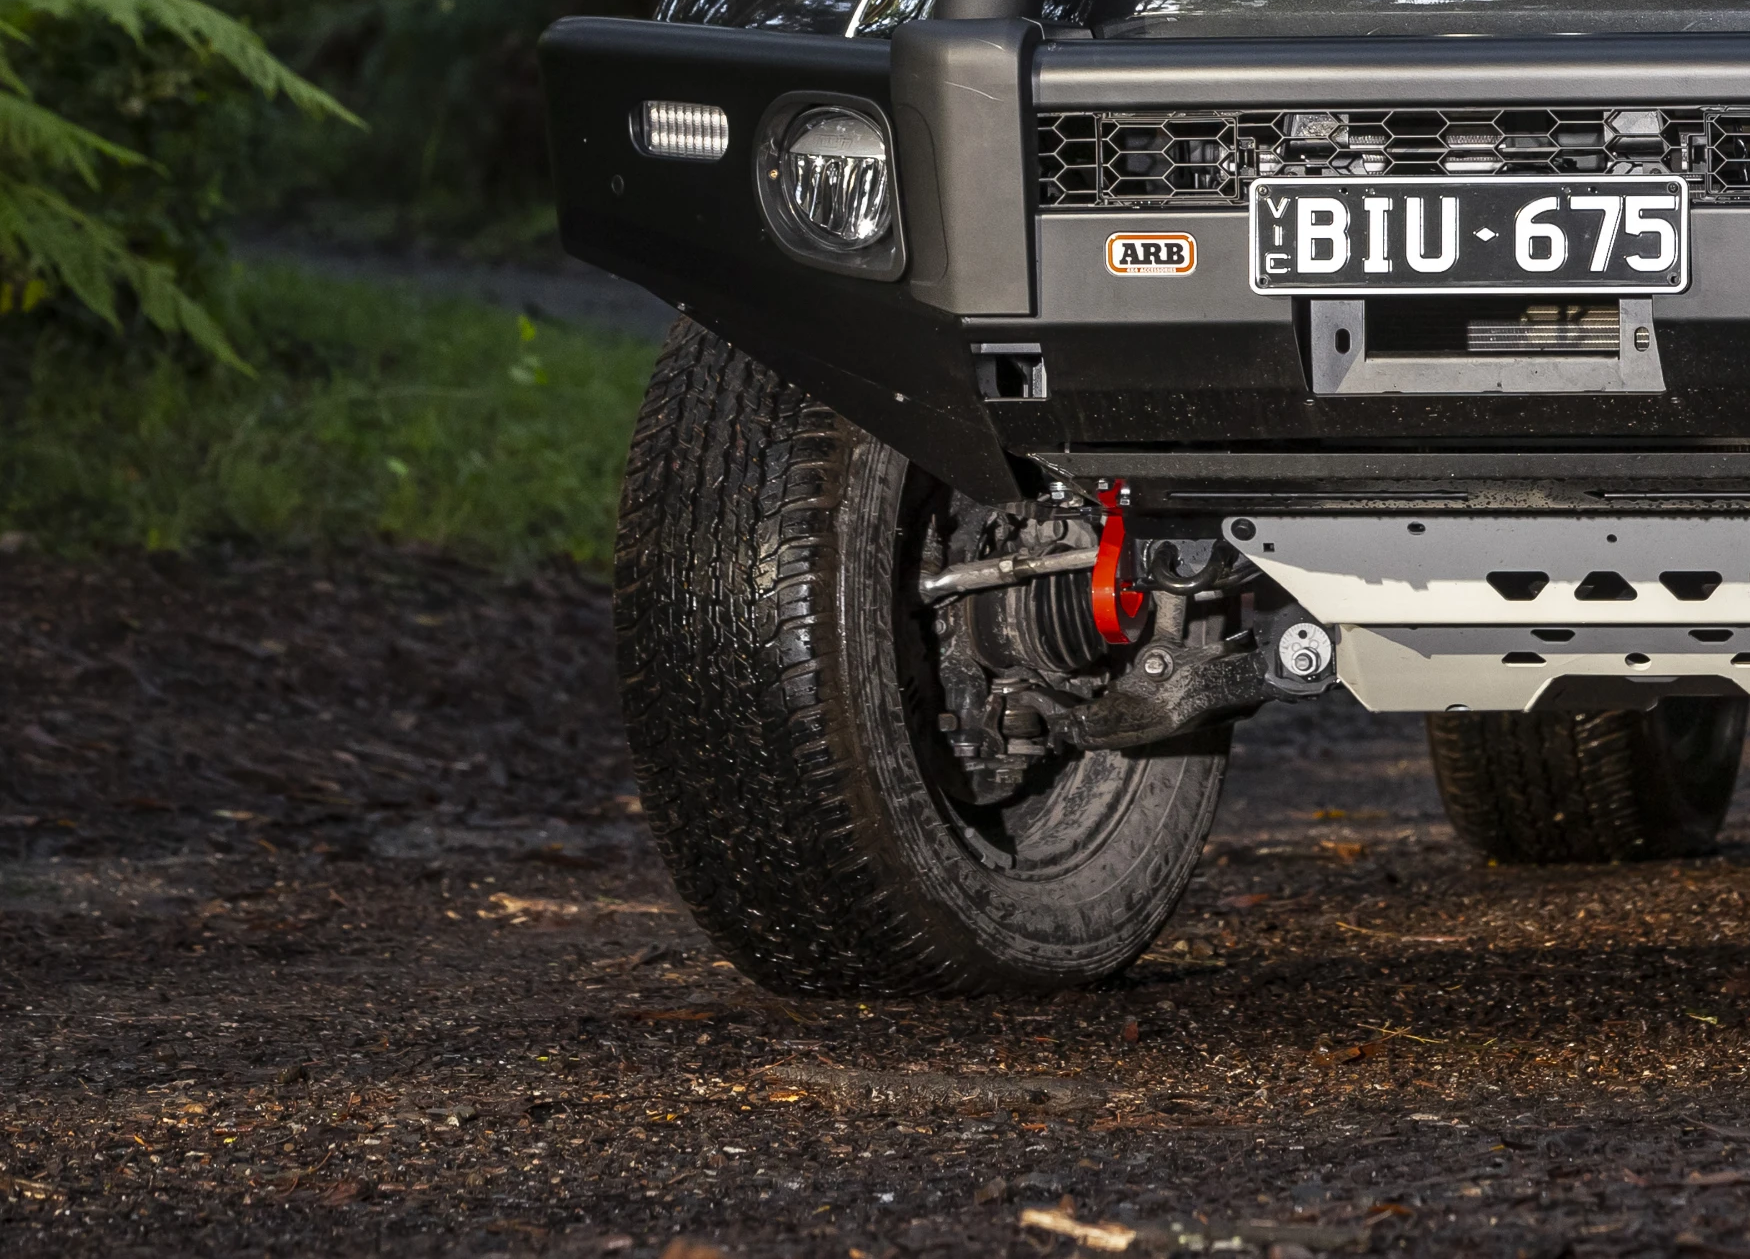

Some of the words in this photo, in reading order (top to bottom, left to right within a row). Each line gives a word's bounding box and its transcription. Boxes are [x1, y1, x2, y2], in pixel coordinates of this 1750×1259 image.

[1119, 242, 1185, 265] ARB
[1264, 195, 1292, 274] VIC
[1296, 195, 1459, 274] BIU
[1514, 195, 1680, 273] 675
